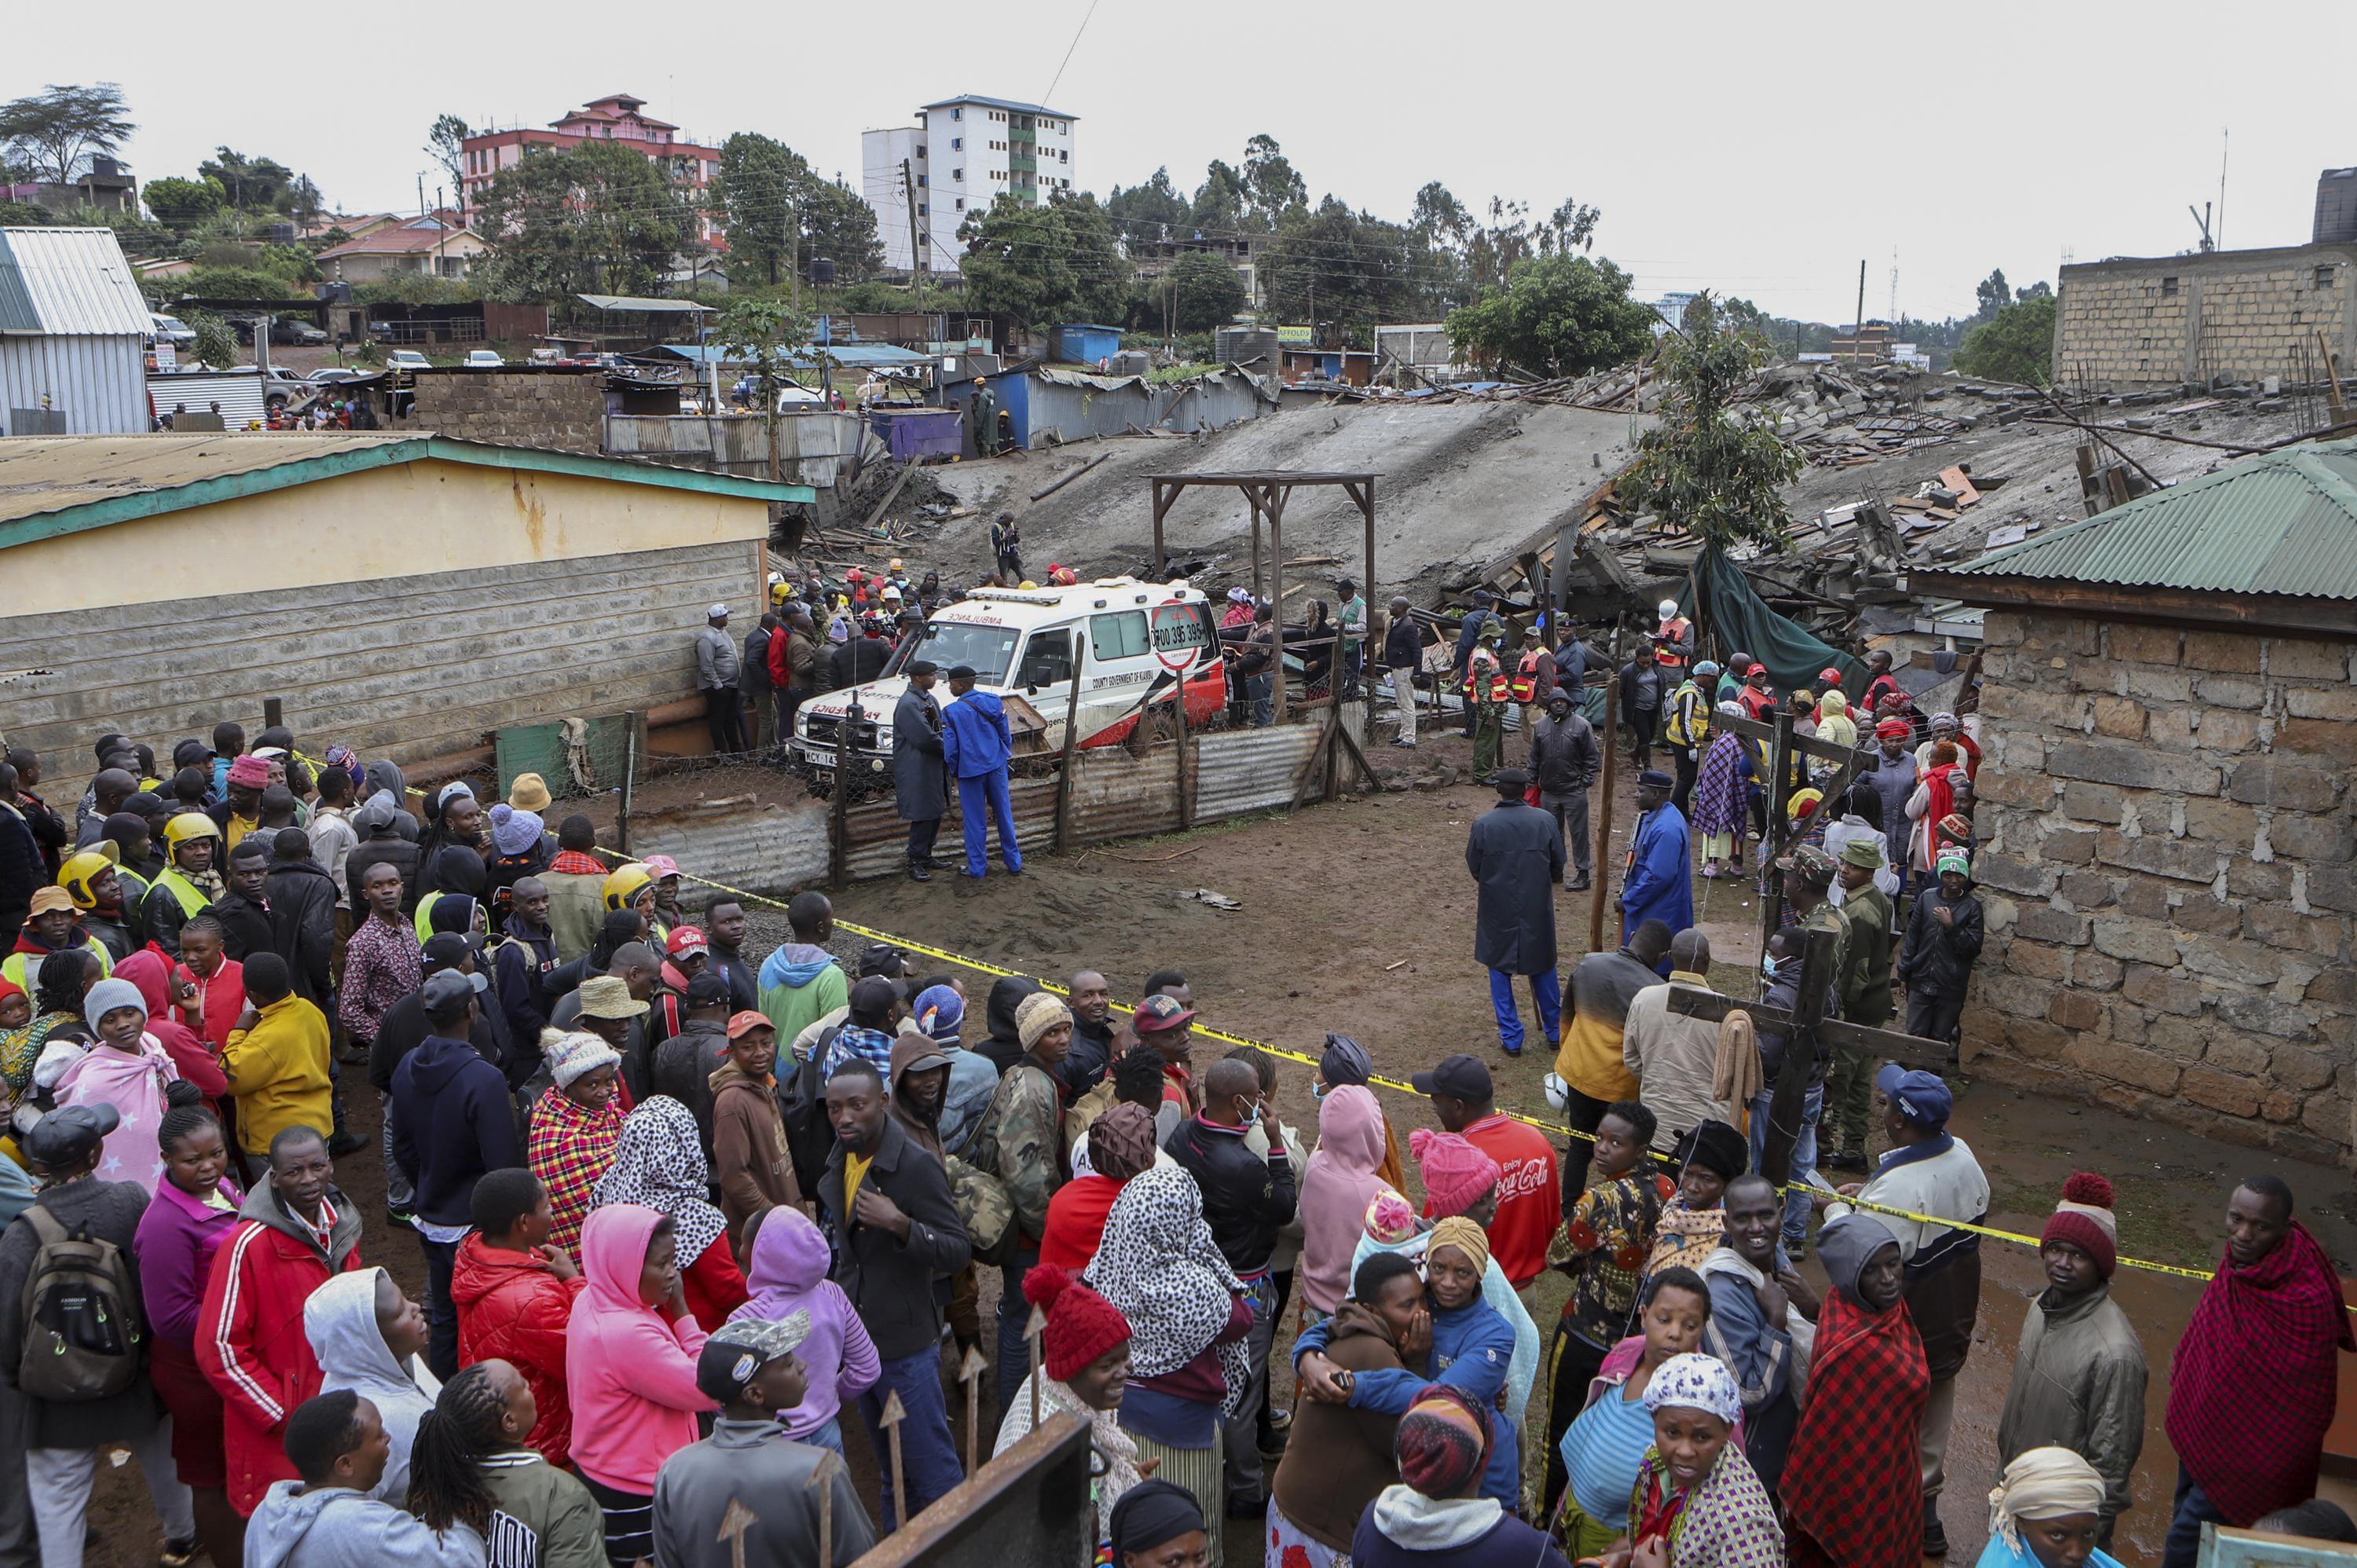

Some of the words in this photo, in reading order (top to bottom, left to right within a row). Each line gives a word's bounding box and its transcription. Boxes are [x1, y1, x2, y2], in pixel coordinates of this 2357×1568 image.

[1151, 628, 1171, 647] 0700
[1171, 625, 1186, 644] 395
[1186, 623, 1202, 642] 395
[1093, 676, 1109, 689] COUNTY
[1109, 672, 1134, 687] GOVERNMENT
[1134, 671, 1139, 682] OF
[805, 751, 821, 765] KCY
[1503, 1158, 1523, 1173] Enjoy
[1494, 1156, 1548, 1199] oca-Cola
